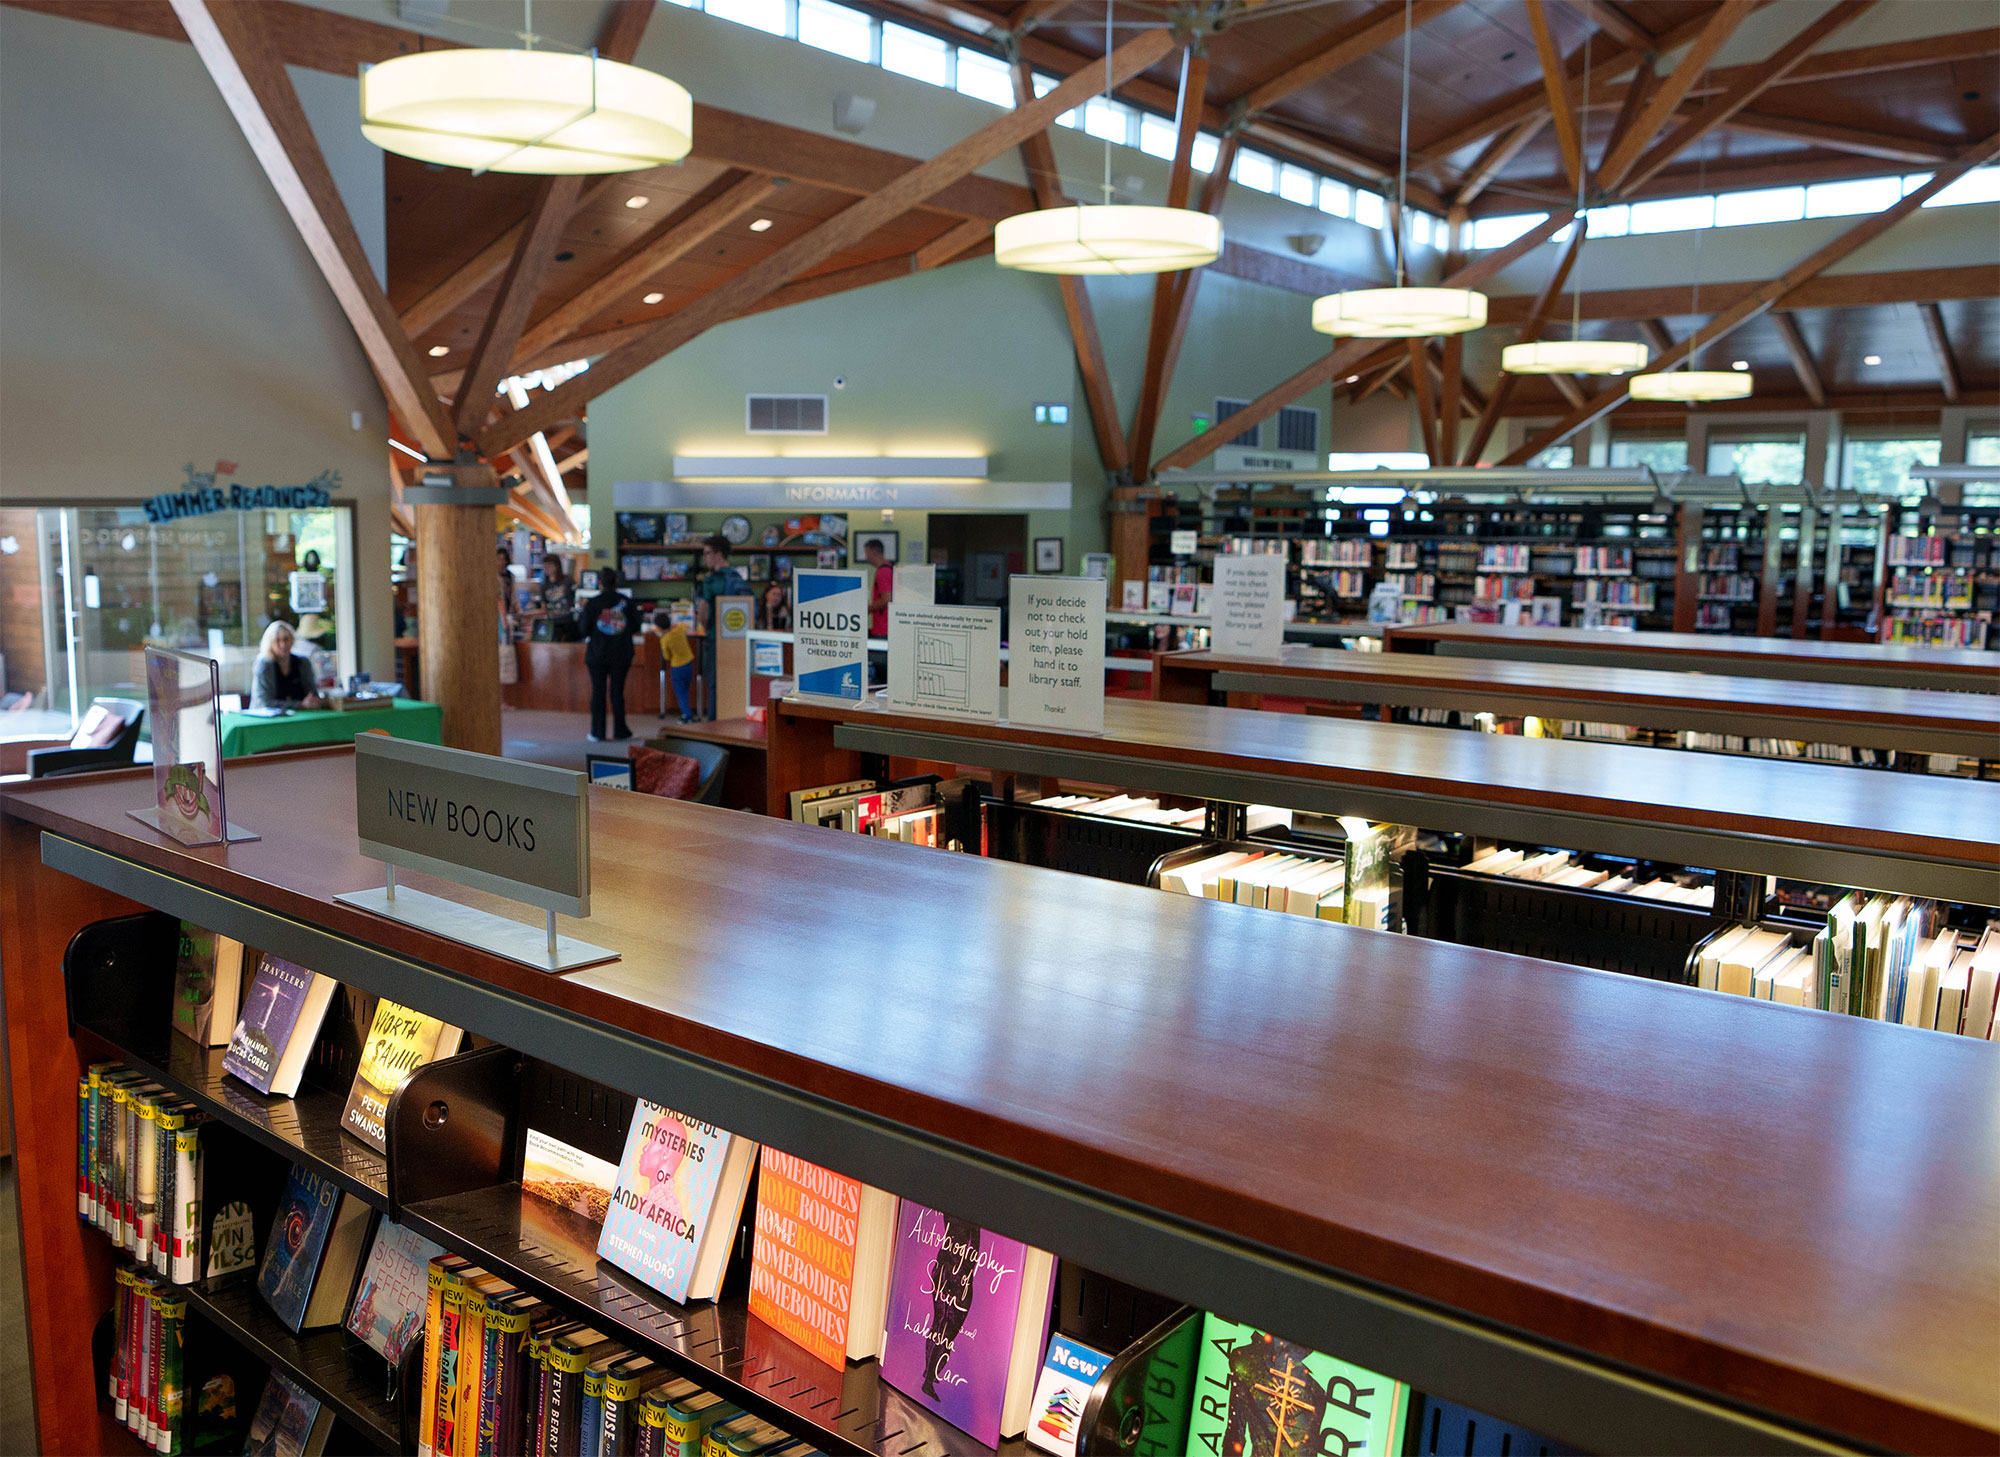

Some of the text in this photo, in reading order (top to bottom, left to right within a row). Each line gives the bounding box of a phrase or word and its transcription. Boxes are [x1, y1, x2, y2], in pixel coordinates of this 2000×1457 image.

[143, 484, 305, 523] SUMMER READING
[785, 487, 898, 501] INFORMATION
[934, 613, 964, 622] alphabetically
[1027, 594, 1086, 608] If you decide
[800, 611, 861, 632] HOLDS
[1025, 628, 1088, 640] out your hold
[1027, 612, 1086, 624] not to check
[801, 638, 819, 646] STILL
[821, 639, 838, 648] NEED
[807, 647, 853, 658] CHECKED OUT
[1029, 642, 1084, 656] item, please
[1028, 674, 1082, 688] library staff.
[1034, 658, 1078, 671] hand it to
[388, 787, 536, 852] NEW BOOKS
[259, 961, 306, 990] TRAVELERS
[374, 1009, 422, 1040] WORTH
[230, 1044, 247, 1060] LUCAS
[247, 1053, 270, 1072] CORREA
[240, 1034, 269, 1055] ARMANDO
[372, 1039, 423, 1072] SAVING
[349, 1108, 387, 1143] SWANSO
[641, 1121, 706, 1163] MYSTERIES
[291, 1160, 332, 1207] KING
[656, 1169, 671, 1184] OF
[761, 1146, 859, 1214] HOMEBODIES
[613, 1185, 696, 1244] ANDY AFRICA
[759, 1171, 855, 1247] HOMEBODIES
[397, 1226, 424, 1252] THE
[756, 1200, 853, 1280] HOMEBODIES
[908, 1208, 1016, 1295] Autobiography
[374, 1240, 420, 1286] SISTER
[609, 1233, 675, 1280] STEPHEN BUORO
[753, 1231, 849, 1313] HOMEBODIES
[374, 1268, 425, 1314] EFFECT
[428, 1273, 443, 1286] EW
[920, 1259, 968, 1313] Skin
[960, 1268, 973, 1301] of
[750, 1262, 846, 1345] HOMEBODIES
[499, 1314, 516, 1328] EW
[777, 1304, 812, 1345] Denton
[814, 1330, 843, 1366] Hurst
[903, 1300, 956, 1352] Lakiesha
[159, 1343, 167, 1381] WOODS
[422, 1357, 430, 1389] THINGS
[934, 1352, 968, 1387] Carr
[1052, 1345, 1098, 1377] New
[437, 1315, 452, 1452] CHAIN-GANG ALL-STARS
[496, 1360, 504, 1396] Atwood
[585, 1382, 602, 1394] EW
[608, 1385, 628, 1397] EW
[549, 1408, 560, 1453] BERRY
[604, 1400, 617, 1441] OUSE
[647, 1408, 666, 1423] EW
[666, 1424, 686, 1438] EW
